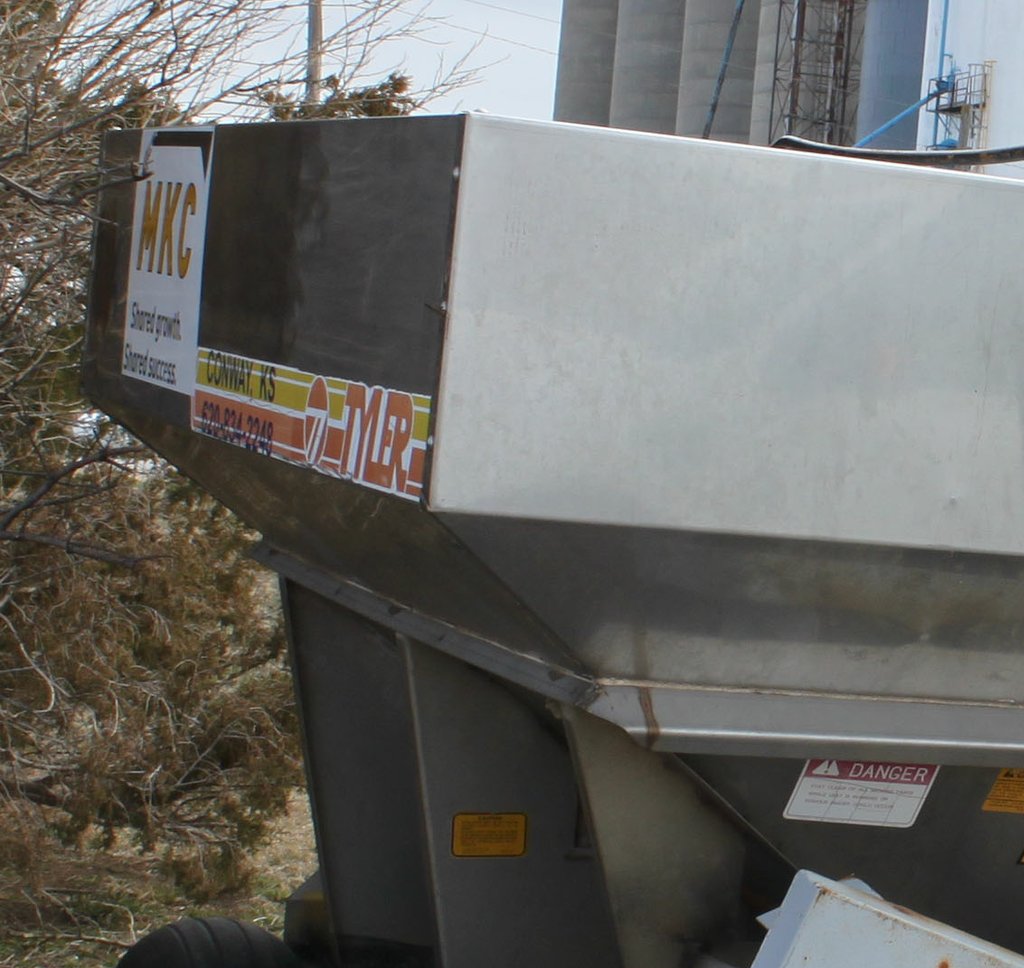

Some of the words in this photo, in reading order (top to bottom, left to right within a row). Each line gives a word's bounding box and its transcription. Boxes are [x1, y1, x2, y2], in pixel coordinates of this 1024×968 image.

[136, 180, 197, 279] MKC
[131, 301, 157, 334] Shared
[123, 343, 149, 376] Shared
[260, 364, 276, 402] KS
[340, 382, 414, 494] TYLER
[849, 762, 929, 783] DANGER
